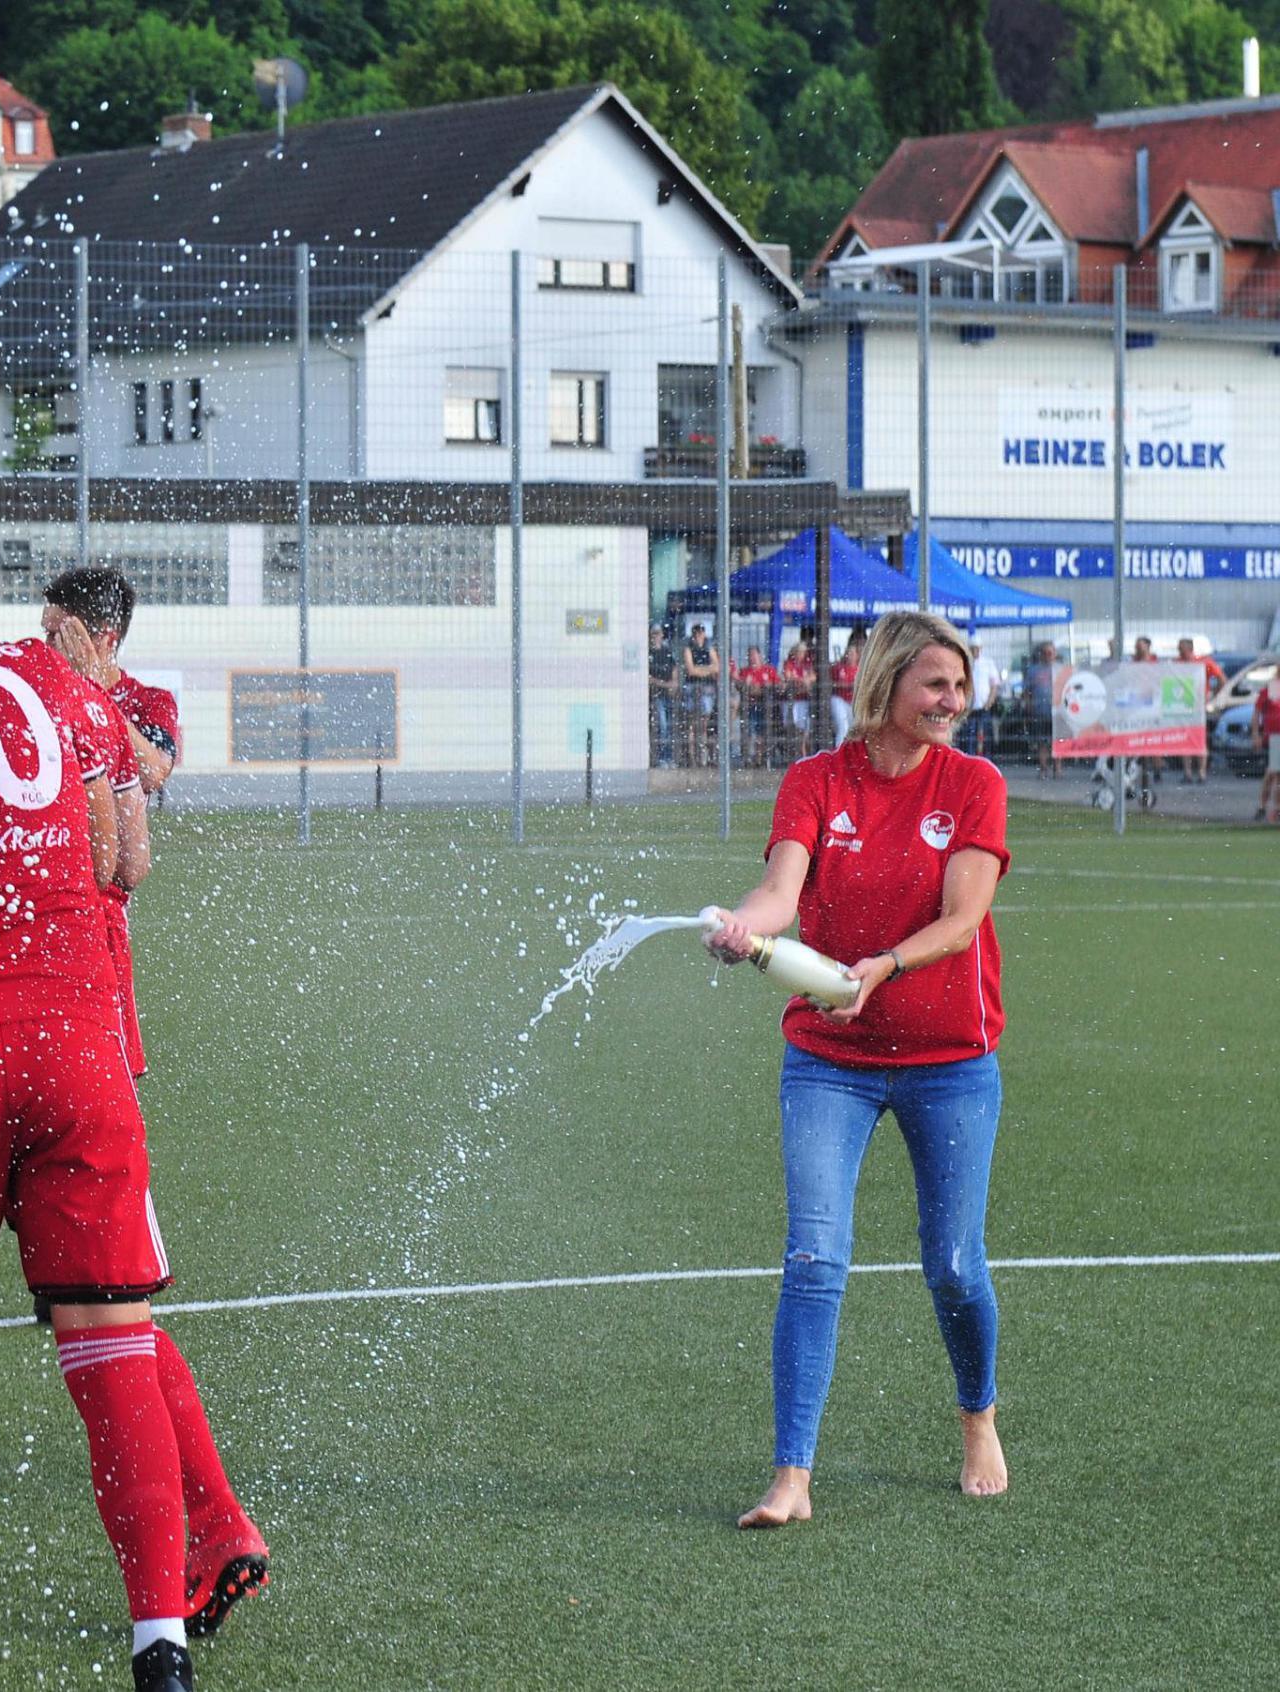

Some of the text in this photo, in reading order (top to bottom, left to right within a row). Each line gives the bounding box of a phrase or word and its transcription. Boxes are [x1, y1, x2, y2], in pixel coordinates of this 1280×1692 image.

[1003, 438, 1106, 467] HEINZE
[1138, 441, 1226, 469] BOLEK
[950, 548, 1012, 578] VIDEO
[1055, 548, 1081, 578] PC
[1123, 549, 1205, 579] TELEKOM
